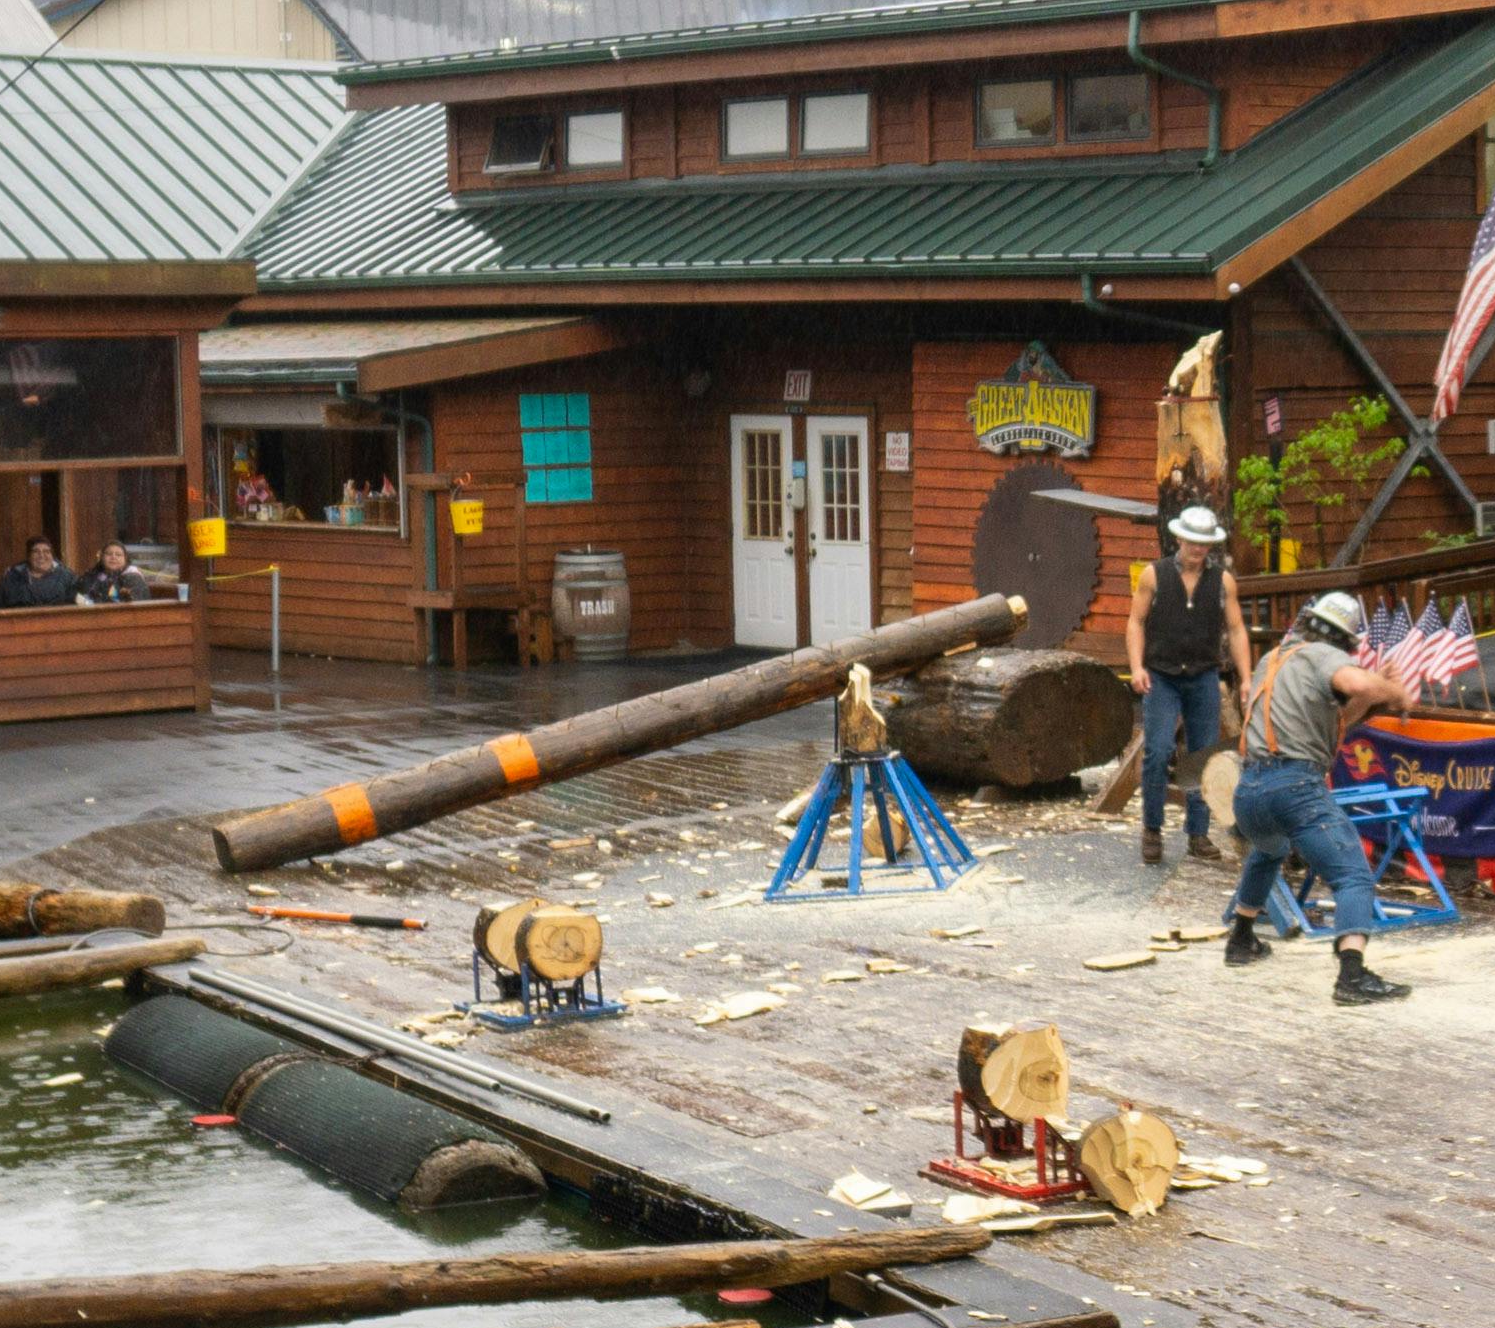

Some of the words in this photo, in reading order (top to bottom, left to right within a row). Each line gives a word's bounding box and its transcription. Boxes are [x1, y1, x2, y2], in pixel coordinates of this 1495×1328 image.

[787, 373, 809, 398] EXIT
[976, 384, 1025, 436] GREAT
[580, 600, 615, 616] TRASH
